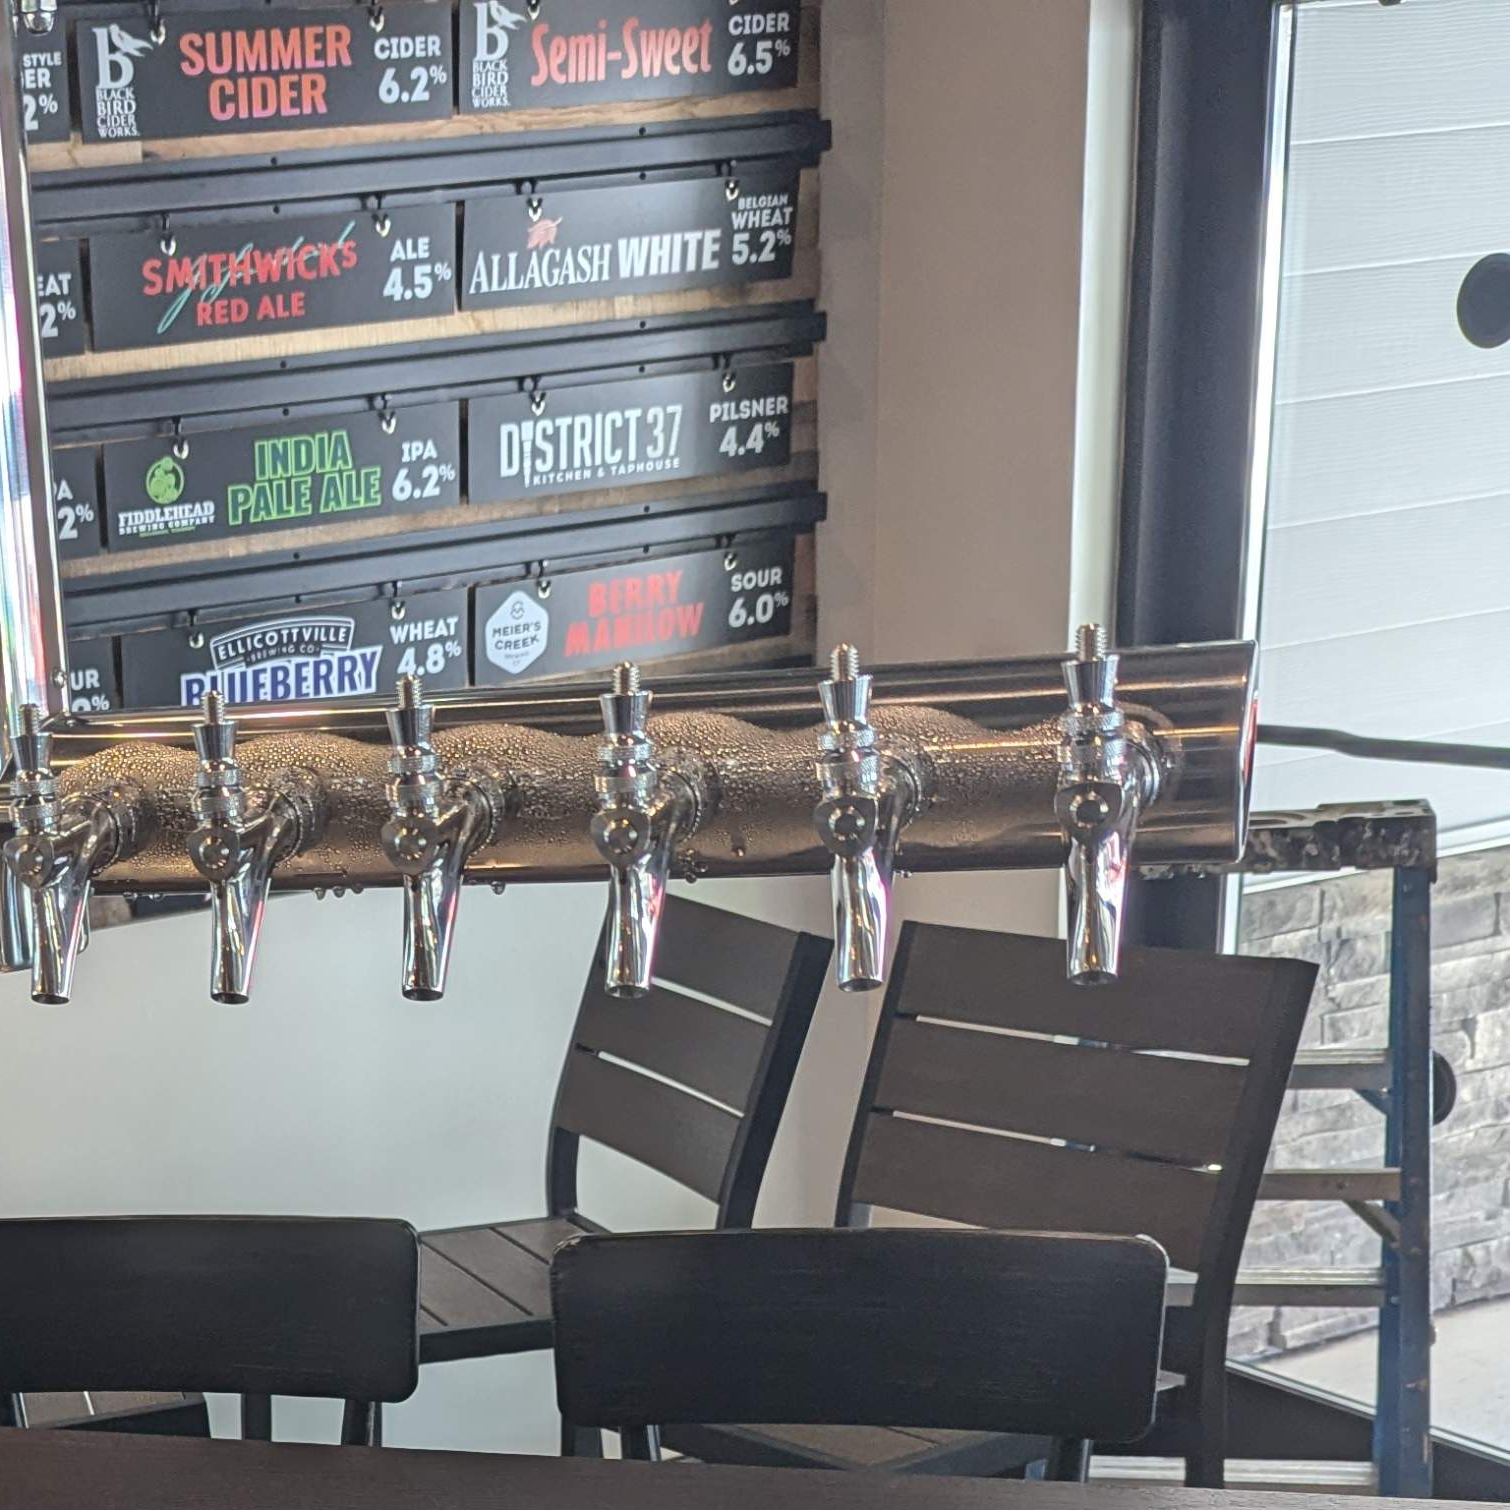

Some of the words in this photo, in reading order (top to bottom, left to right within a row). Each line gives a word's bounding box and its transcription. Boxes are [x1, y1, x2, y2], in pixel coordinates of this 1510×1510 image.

[728, 12, 790, 36] CIDER
[22, 51, 62, 67] STYLE
[179, 25, 352, 76] SUMMER
[374, 36, 442, 60] CIDER
[530, 19, 713, 87] Semi-Sweet
[727, 39, 790, 76] 6.5%
[472, 59, 508, 73] BLACK
[472, 72, 509, 88] BIRD
[96, 87, 136, 101] BLACK
[209, 73, 328, 122] CIDER
[378, 66, 447, 104] 6.2%
[471, 85, 508, 98] CIDER
[23, 93, 59, 131] 2%
[96, 100, 137, 116] BIRD
[96, 114, 137, 128] CIDER
[738, 194, 788, 211] BELGIAN
[731, 207, 793, 230] WHEAT
[391, 237, 430, 262] ALE
[732, 228, 792, 265] 5.2%
[468, 243, 611, 296] ALLAGASH
[618, 228, 722, 278] WHITE
[37, 273, 72, 297] EAT
[382, 262, 452, 301] 4.5%
[40, 301, 76, 338] 2%
[196, 299, 249, 327] RED
[257, 292, 305, 319] ALE
[709, 397, 788, 423] PILSNER
[401, 440, 438, 462] IPA
[500, 407, 640, 486] DISTRICT
[647, 405, 683, 459] 37
[719, 420, 781, 458] 4.4%
[254, 430, 353, 480] INDIA
[392, 463, 455, 501] 6.2%
[533, 467, 591, 486] KITCHEN
[597, 466, 606, 478] &
[611, 457, 681, 477] TAPHOUSE
[227, 480, 312, 526] PALE
[319, 465, 383, 512] ALE
[57, 503, 94, 540] 2%
[118, 501, 216, 527] FIDDLEHEAD
[118, 523, 166, 536] BREWING
[168, 515, 216, 530] COMPANY
[589, 570, 683, 618] BERRY
[731, 568, 782, 592] SOUR
[728, 591, 789, 629] 6.0%
[218, 625, 348, 660] ELLICOTTVILLE
[391, 616, 458, 644] WHEAT
[492, 620, 542, 639] MEIER'S
[494, 634, 540, 651] CREEK
[397, 641, 461, 676] 4.8%
